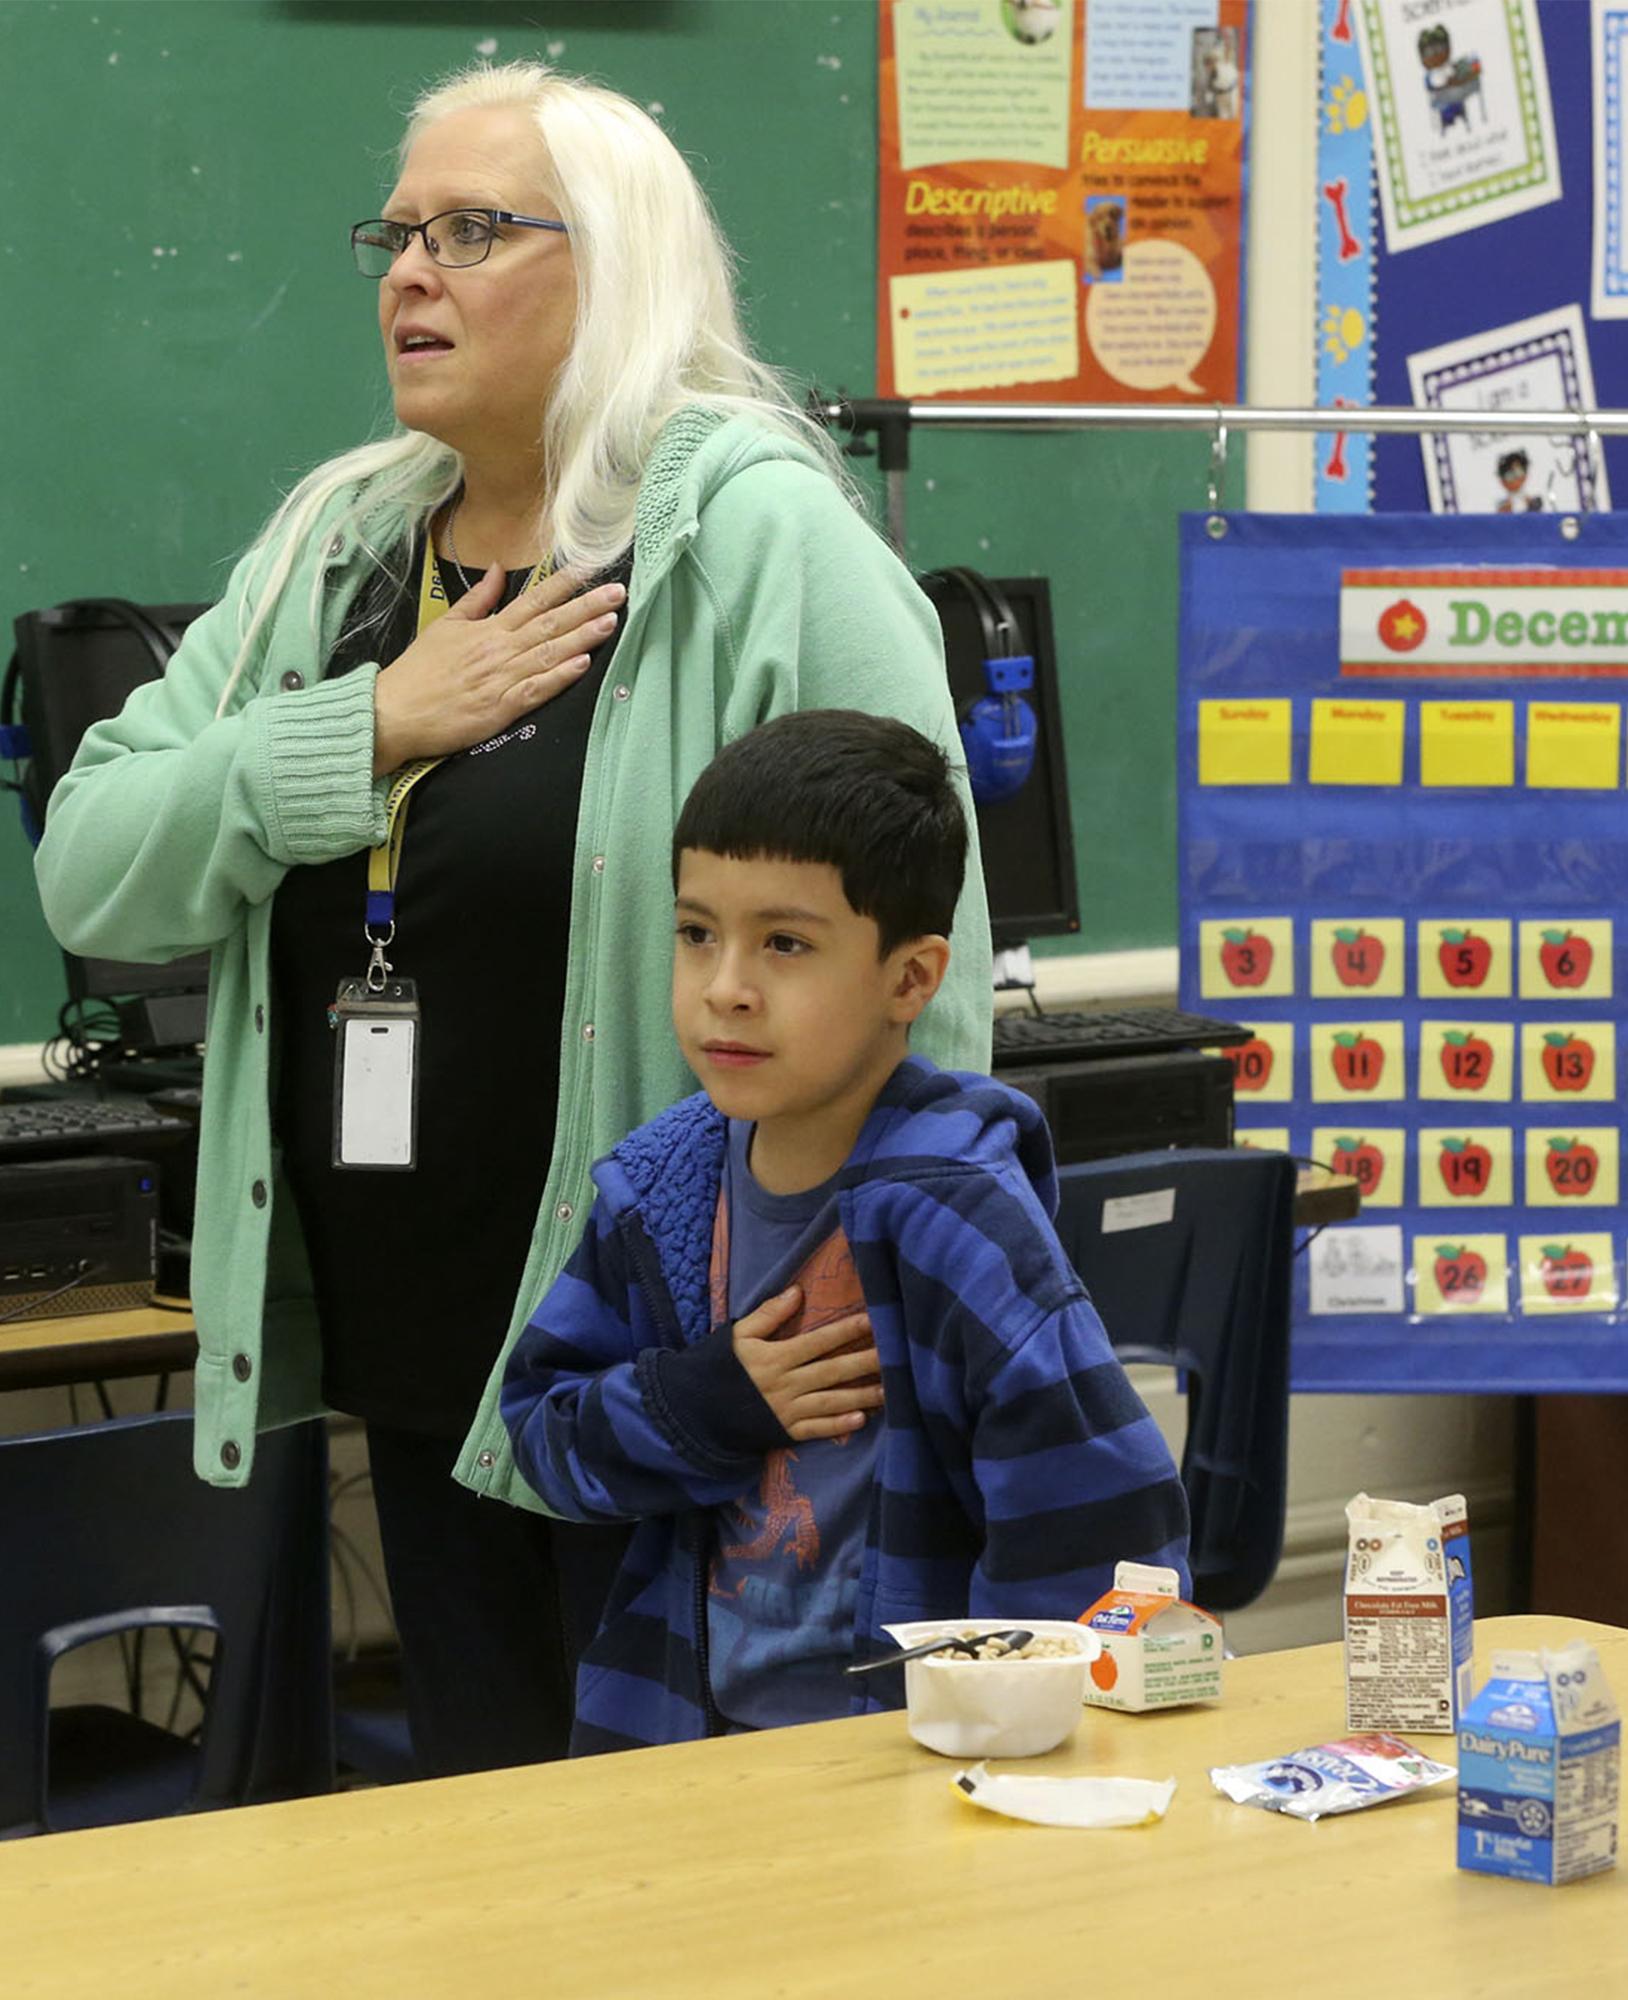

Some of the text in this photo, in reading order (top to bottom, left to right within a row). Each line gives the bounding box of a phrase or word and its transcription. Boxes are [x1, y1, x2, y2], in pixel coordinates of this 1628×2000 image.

[1081, 131, 1208, 164] Persuasive
[905, 180, 1058, 223] Descriptive
[1219, 707, 1269, 721] Sunday
[1331, 707, 1386, 722] Monday
[1440, 708, 1495, 724] Tuesday
[1534, 710, 1612, 725] Wednesday
[1238, 950, 1257, 975] 3
[1347, 949, 1366, 974] 4
[1457, 949, 1474, 975] 5
[1558, 950, 1575, 975] 6
[1234, 1053, 1263, 1079] 10
[1348, 1053, 1368, 1078] 11
[1453, 1053, 1481, 1079] 12
[1555, 1053, 1584, 1079] 13
[1344, 1157, 1373, 1183] 18
[1452, 1157, 1481, 1183] 19
[1554, 1158, 1592, 1184] 20
[1444, 1266, 1479, 1292] 26
[1552, 1266, 1585, 1292] 27
[1461, 1730, 1552, 1765] DairyPure
